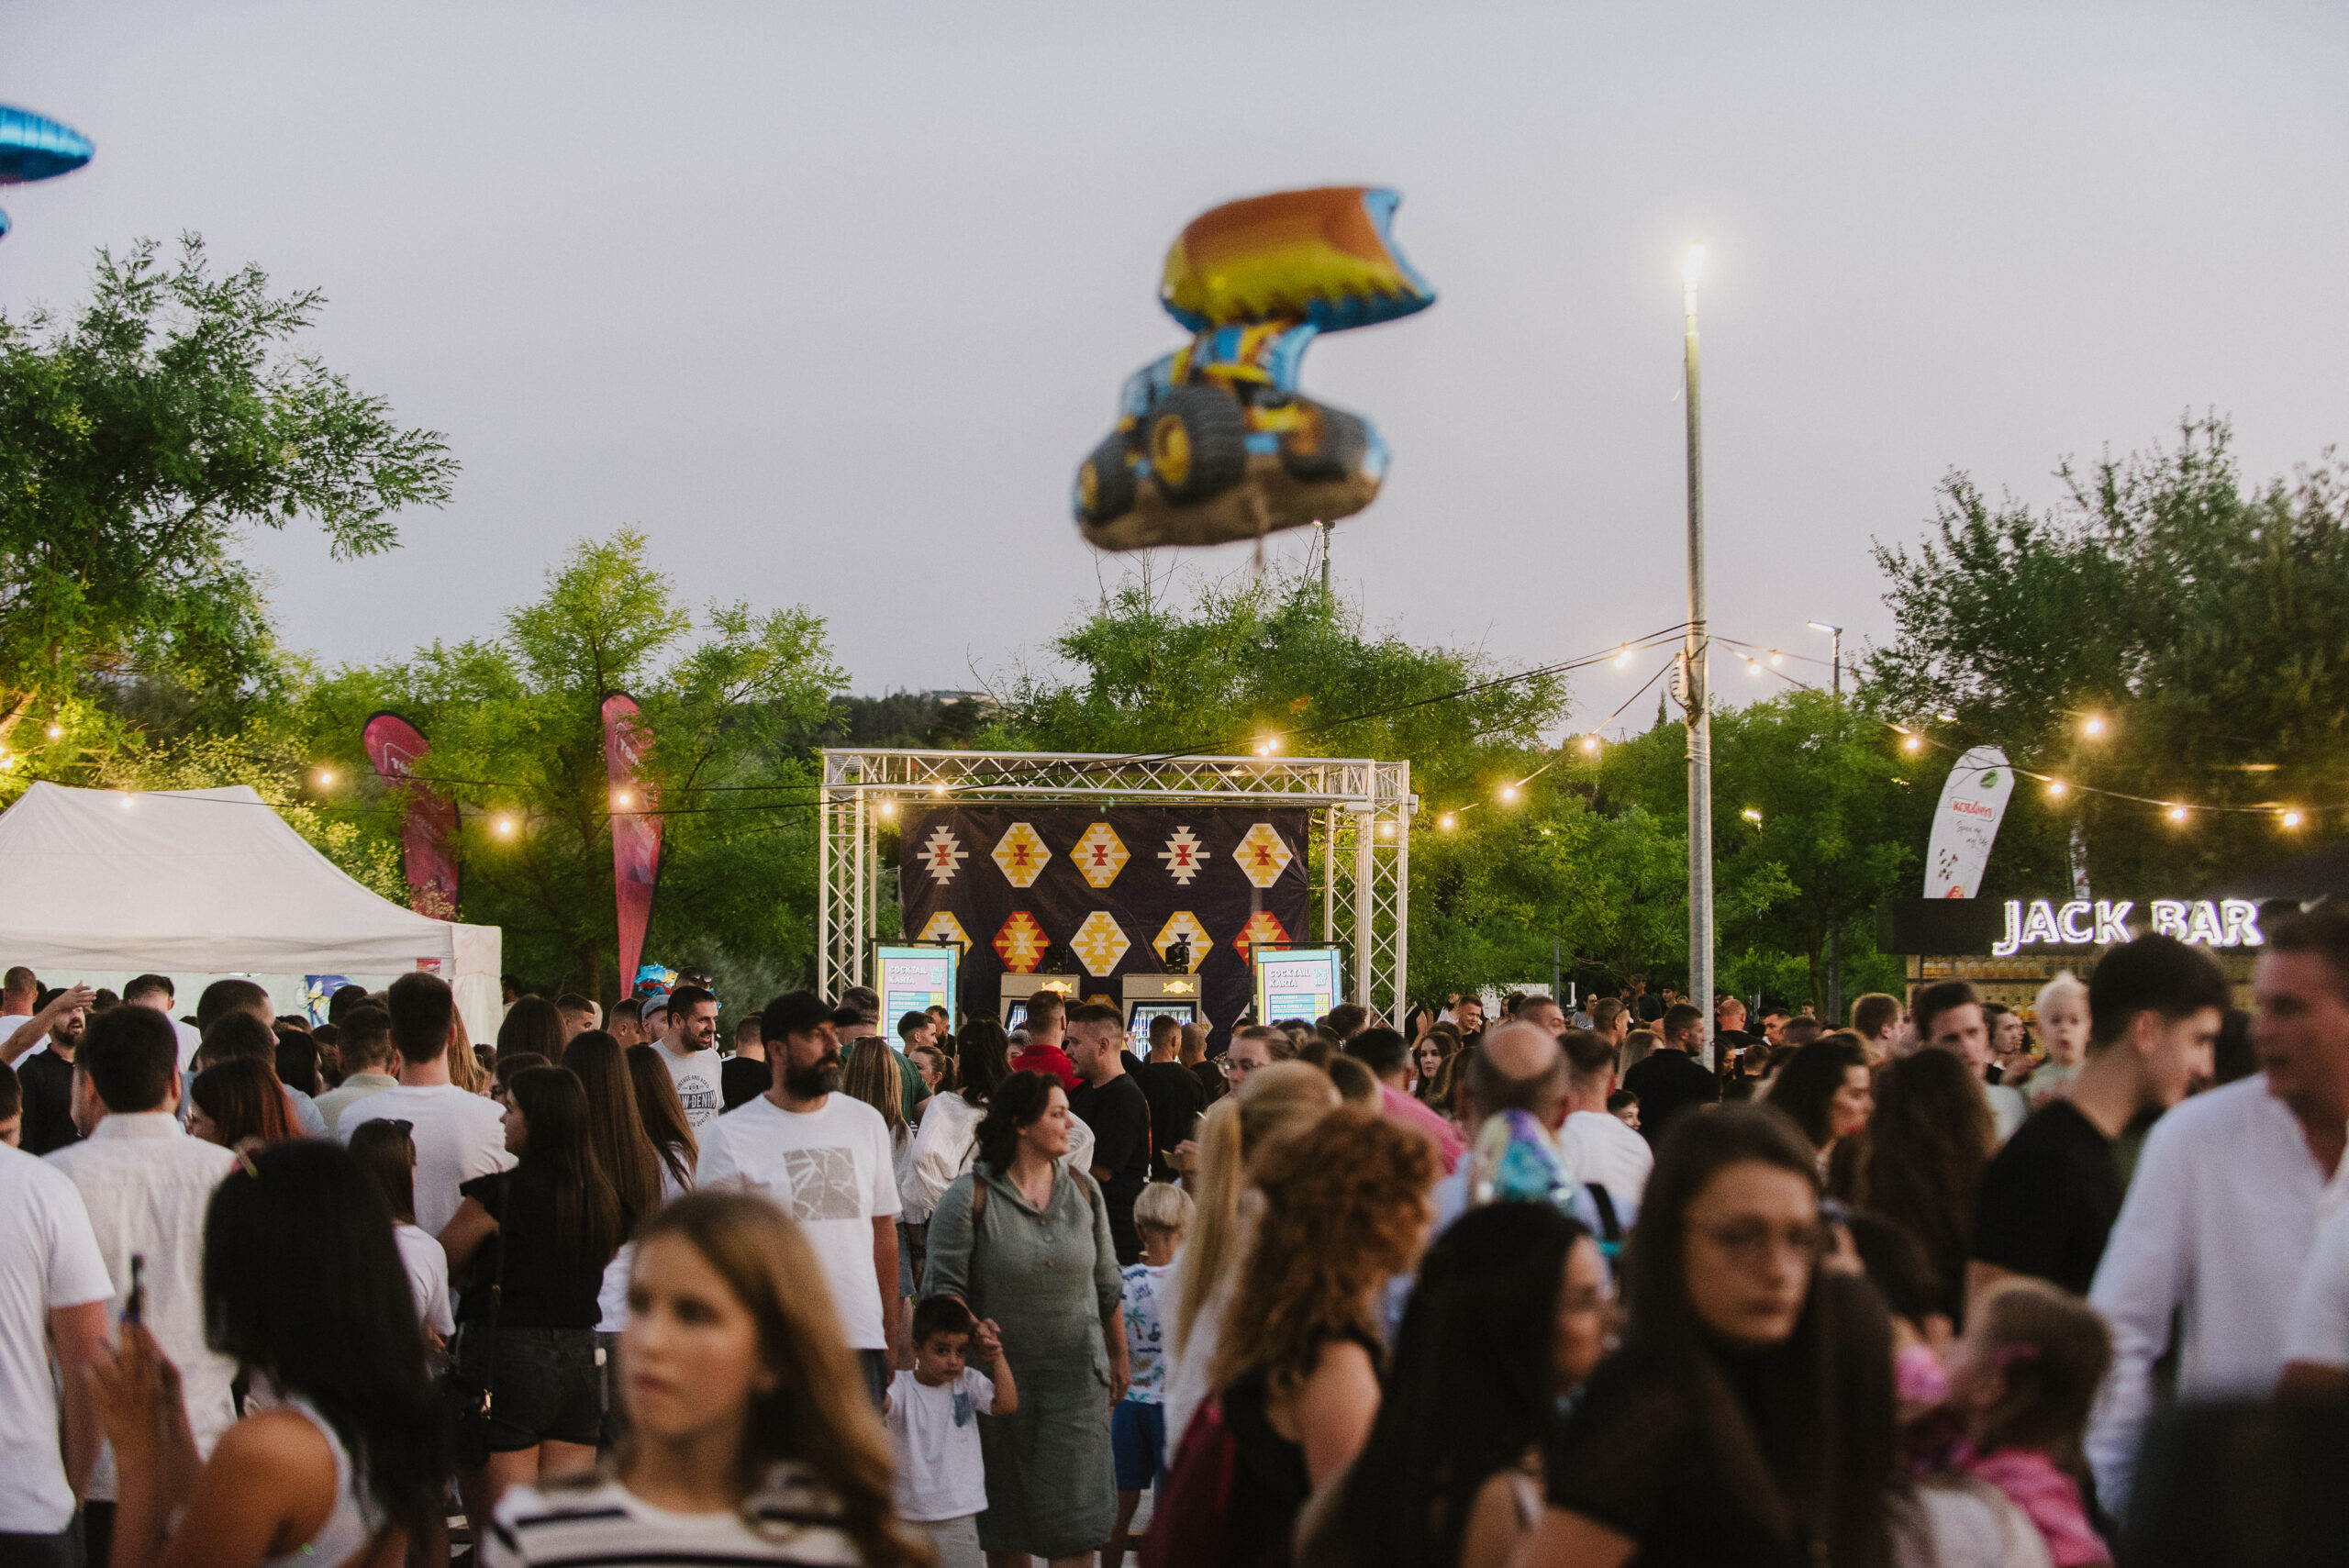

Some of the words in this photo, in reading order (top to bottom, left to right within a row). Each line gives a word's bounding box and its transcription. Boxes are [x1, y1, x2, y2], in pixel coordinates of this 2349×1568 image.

[1992, 899, 2133, 956] JACK
[2151, 898, 2265, 946] BAR
[888, 965, 928, 974] COCKTAIL
[1270, 968, 1310, 977] COCKTAIL
[1270, 978, 1298, 987] KARTA
